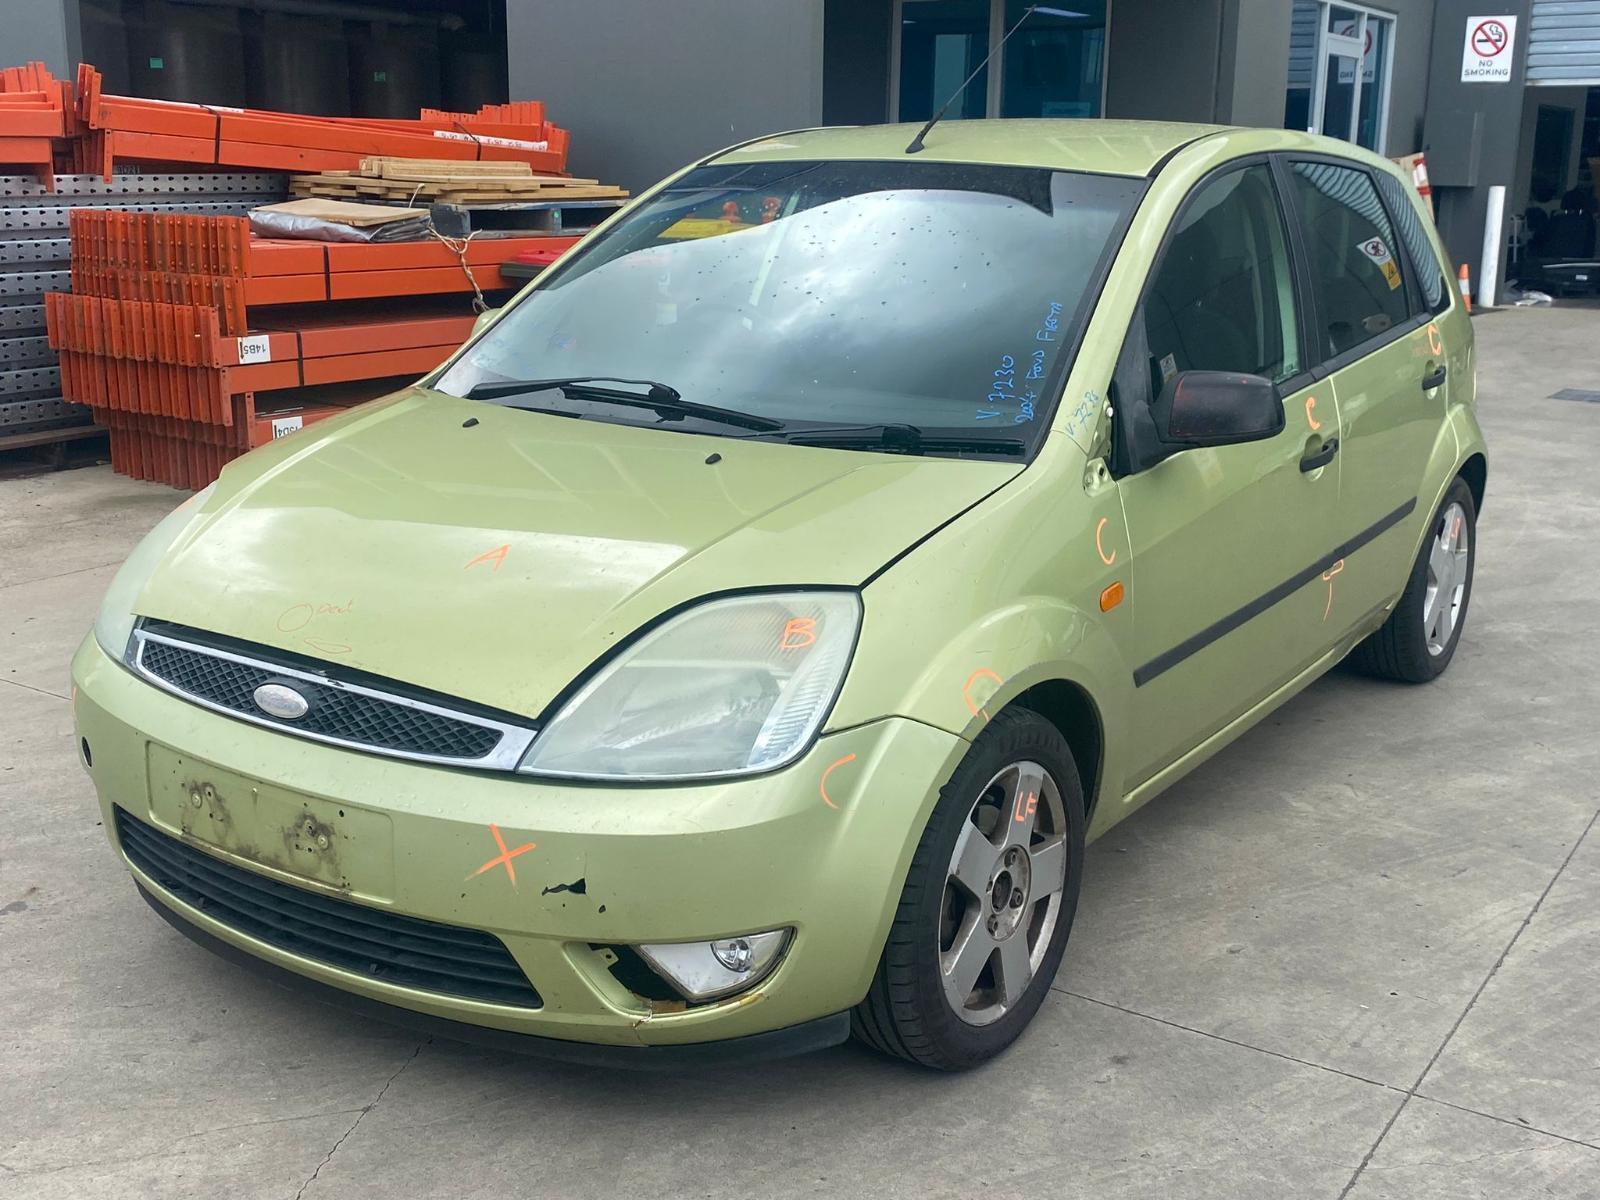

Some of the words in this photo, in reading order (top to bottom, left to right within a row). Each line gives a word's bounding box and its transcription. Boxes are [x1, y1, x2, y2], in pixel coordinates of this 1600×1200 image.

[1464, 68, 1509, 76] SMOKING
[243, 343, 266, 355] 14B5
[463, 543, 511, 572] A
[780, 618, 817, 650] B
